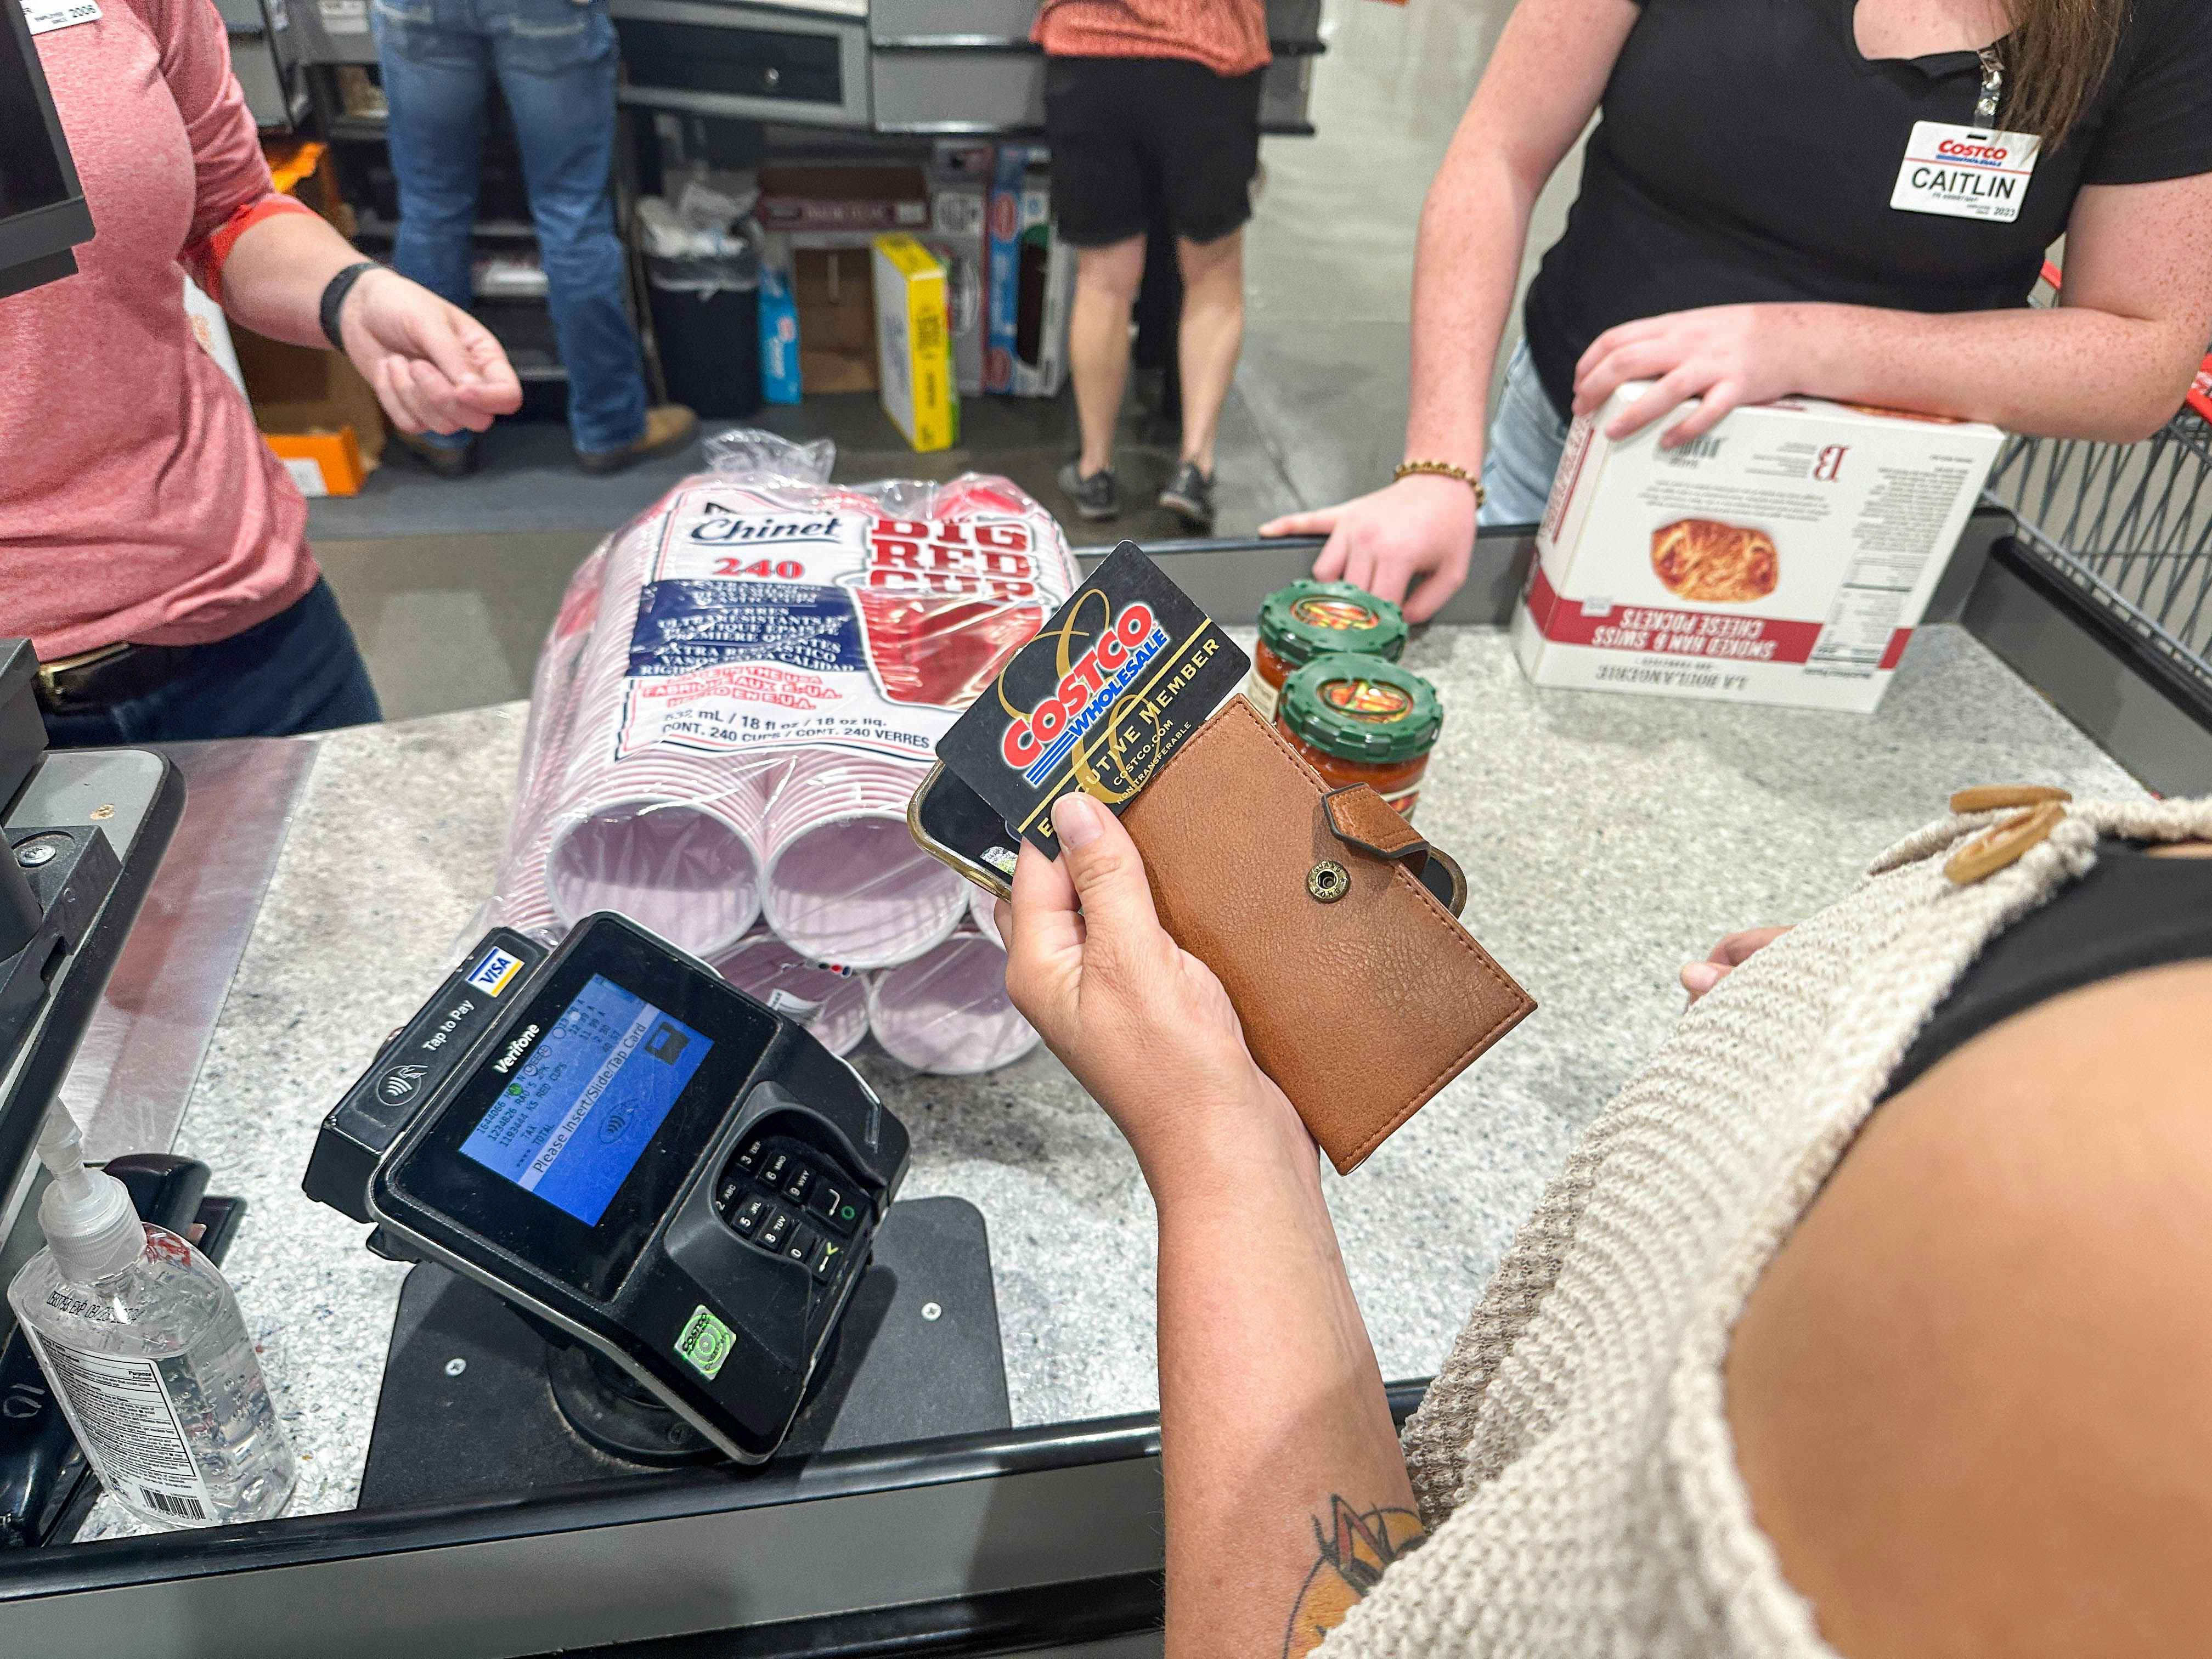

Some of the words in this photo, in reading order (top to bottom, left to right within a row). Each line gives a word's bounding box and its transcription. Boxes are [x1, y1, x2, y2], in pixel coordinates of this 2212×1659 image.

[1938, 139, 2008, 160] COSTCO
[1911, 168, 2017, 199] CAITLIN
[691, 517, 843, 540] Chinet
[871, 520, 1028, 551] BIG
[712, 557, 805, 579] 240
[871, 538, 1032, 580] RED
[870, 569, 1036, 602] CUP
[1619, 608, 1697, 633] POCKETS
[1696, 614, 1765, 638] CHEESE
[1592, 625, 1650, 649] SWISS
[1706, 636, 1776, 659] SMOKED
[734, 676, 777, 692] AUX
[746, 665, 782, 682] THE
[785, 673, 823, 685] USA
[1002, 606, 1153, 767] COSTCO
[1067, 628, 1167, 735] WHOLESALE
[733, 687, 759, 701] EN
[698, 709, 724, 723] mL
[729, 713, 737, 725] /
[741, 715, 760, 730] 18
[764, 720, 776, 730] fl
[804, 718, 811, 726] /
[816, 717, 835, 726] 18
[863, 718, 887, 727] liq.
[662, 721, 706, 736] CONT.
[709, 726, 738, 742] 240
[741, 732, 781, 742] CUPS
[795, 727, 839, 737] CONT.
[844, 727, 871, 737] 240
[874, 729, 930, 749] VERRES
[1037, 725, 1141, 838] ECUTIVE
[1138, 638, 1220, 726] MEMBER
[1110, 718, 1175, 787] COSTCO.COM
[478, 956, 512, 986] VISA
[422, 1032, 447, 1051] Tap
[439, 1020, 456, 1032] to
[449, 1000, 475, 1020] Pay
[494, 1024, 540, 1073] Verifone
[487, 1107, 517, 1142] 1234826
[568, 1012, 590, 1035] 1299
[499, 1113, 528, 1148] 1193444
[526, 1099, 539, 1111] KS
[535, 1082, 551, 1099] RED
[548, 1062, 567, 1081] CUPS
[579, 1017, 600, 1040] 1199
[532, 1132, 568, 1173] Please
[562, 1049, 629, 1133] Insert/Slide/Tap
[623, 1022, 646, 1049] Card
[531, 1122, 555, 1146] TOTAL
[741, 1155, 752, 1165] 3
[750, 1141, 761, 1154] DEF
[766, 1171, 776, 1180] 6
[715, 1201, 725, 1210] 2
[724, 1184, 736, 1199] ABC
[790, 1187, 800, 1196] 9
[740, 1217, 751, 1227] 5
[751, 1202, 761, 1215] JKL
[765, 1233, 776, 1243] 8
[773, 1215, 786, 1230] TUV
[791, 1249, 802, 1258] 0
[69, 1300, 88, 1315] EXP
